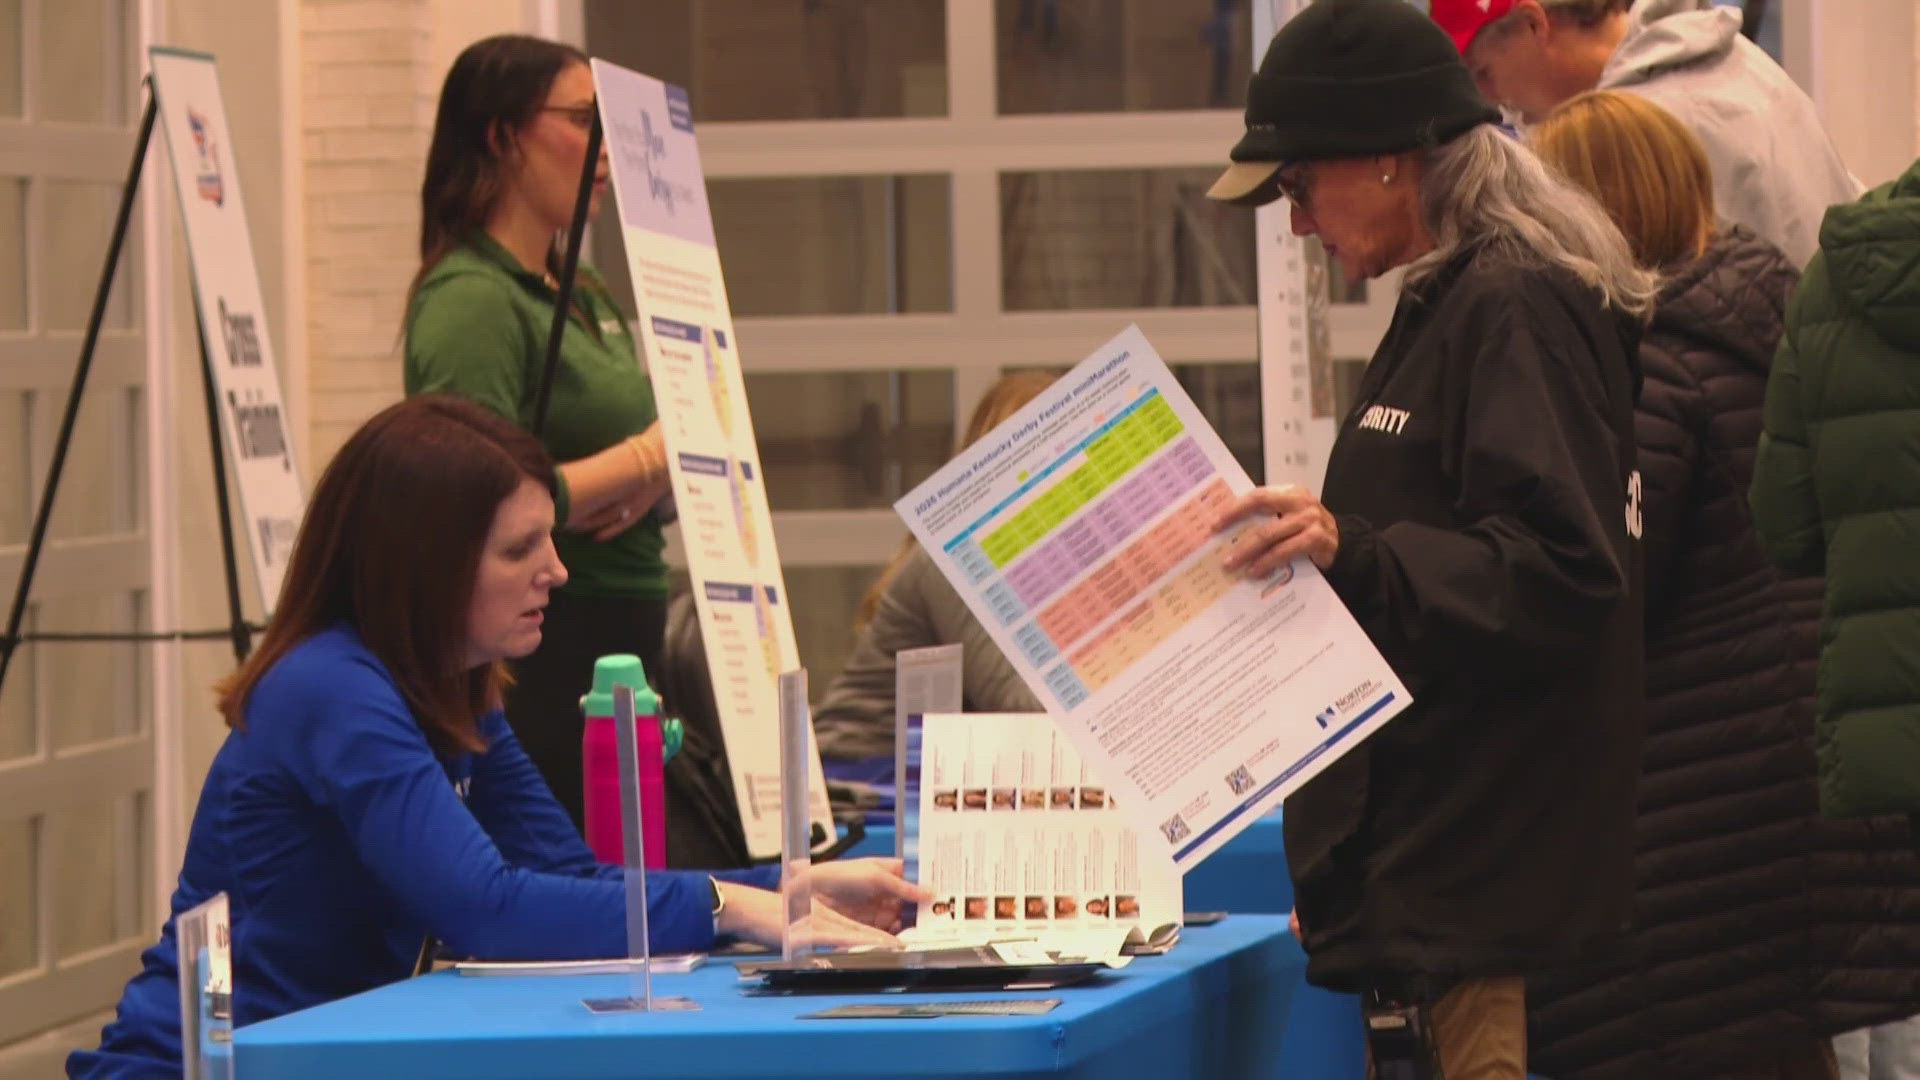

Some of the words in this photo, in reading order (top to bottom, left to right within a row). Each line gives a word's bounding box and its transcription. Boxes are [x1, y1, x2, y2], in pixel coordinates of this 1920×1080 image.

[937, 469, 973, 499] Humana
[972, 440, 1012, 473] Kentucky
[1012, 420, 1039, 442] Derby
[1038, 392, 1072, 421] Festival
[1072, 350, 1131, 397] miniMarathon
[1358, 404, 1411, 436] URITY
[1335, 678, 1372, 708] NORTON
